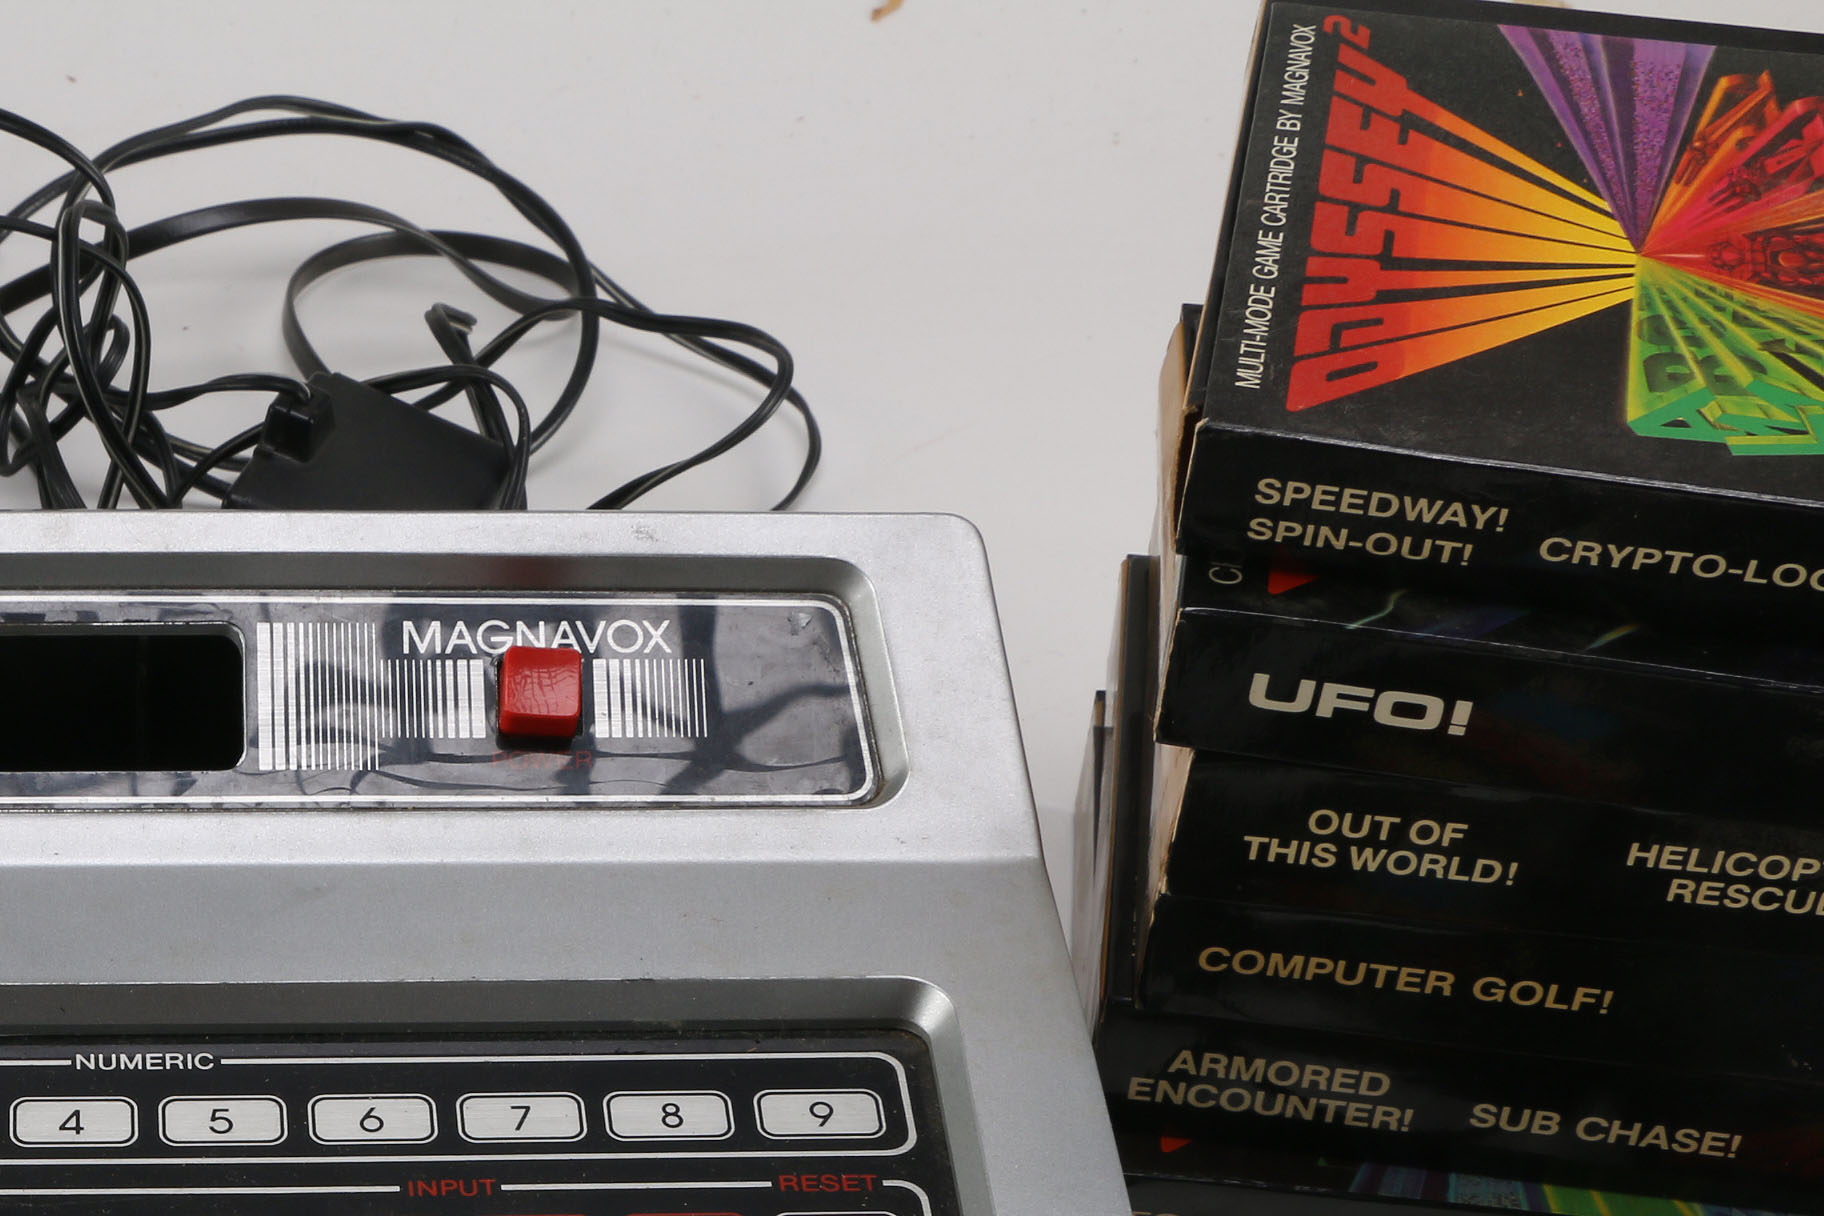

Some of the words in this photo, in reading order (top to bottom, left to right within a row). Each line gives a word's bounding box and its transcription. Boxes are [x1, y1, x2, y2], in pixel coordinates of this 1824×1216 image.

[1284, 23, 1317, 106] MAGNAVOX
[1277, 110, 1302, 132] BY
[1260, 136, 1299, 228] CARTRIDGE
[1252, 230, 1284, 279] GAME
[1235, 284, 1276, 389] MULTI-MODE
[1254, 477, 1510, 533] SPEEDWAY!
[1247, 516, 1473, 567] SPIN-OUT!
[402, 619, 673, 655] MAGNAVOX
[1247, 672, 1474, 737] UFO!
[491, 750, 594, 769] POWER
[1307, 807, 1401, 843] OUT
[1408, 816, 1468, 847] OF
[1243, 834, 1339, 869] THIS
[1349, 845, 1519, 887] WORLD!
[1626, 841, 1824, 883] HELICOP
[1665, 877, 1824, 918] RESCU
[1197, 945, 1456, 997] COMPUTER
[1470, 975, 1615, 1015] GOLF!
[76, 1052, 215, 1071] NUMERIC
[1167, 1049, 1392, 1098] ARMORED
[58, 1109, 85, 1135] 4
[209, 1108, 234, 1135] 5
[359, 1107, 384, 1133] 6
[510, 1105, 531, 1131] 7
[661, 1102, 684, 1129] 8
[809, 1101, 834, 1127] 9
[1127, 1077, 1414, 1133] ENCOUNTER!
[1467, 1103, 1561, 1136] SUB
[1574, 1114, 1742, 1160] CHASE!
[407, 1178, 496, 1198] INPUT
[779, 1173, 877, 1194] RESET
